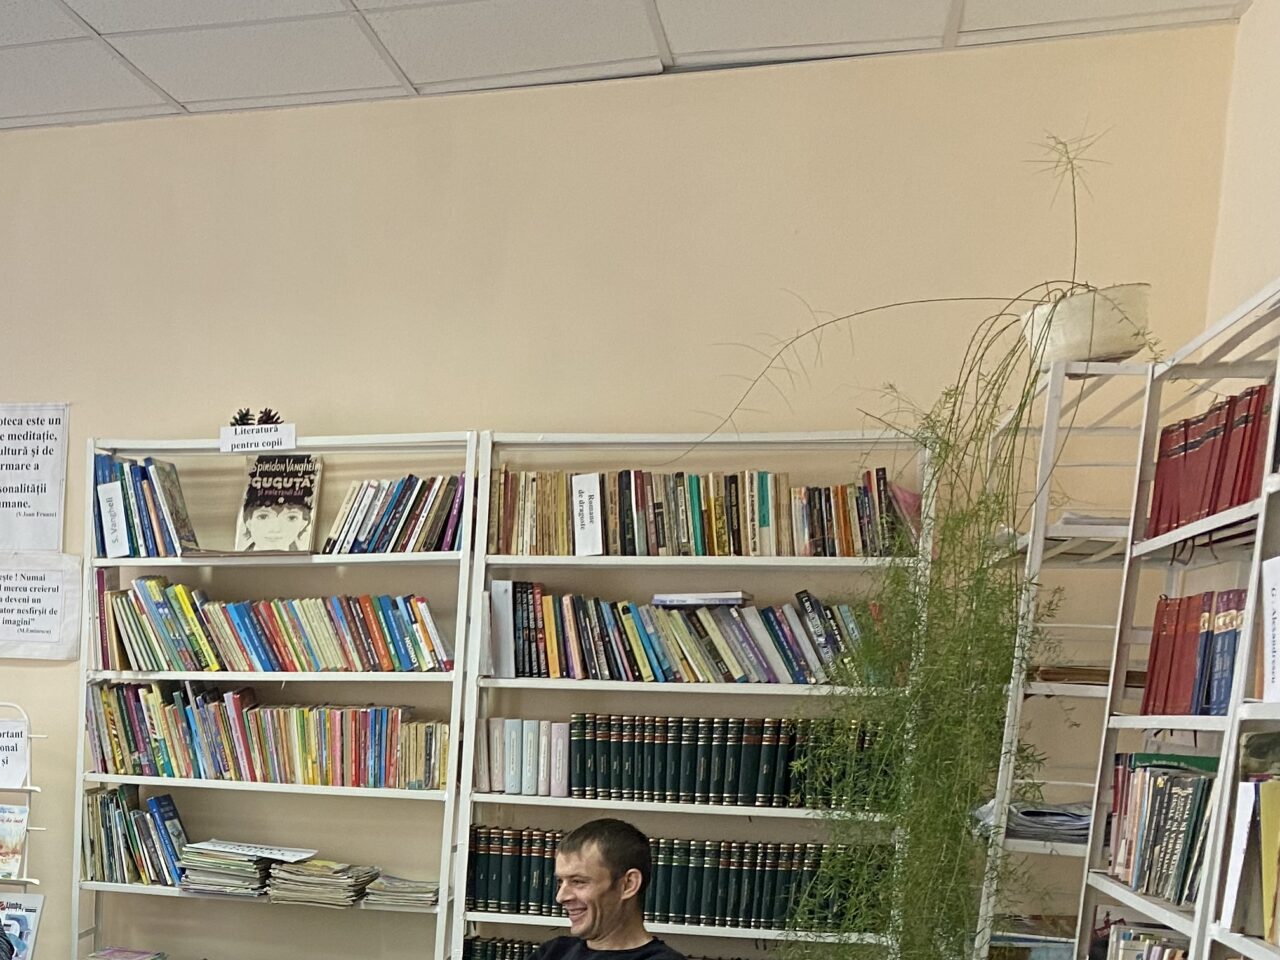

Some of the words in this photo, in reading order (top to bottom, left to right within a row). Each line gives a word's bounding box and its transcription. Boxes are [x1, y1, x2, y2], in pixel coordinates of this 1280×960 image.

[26, 416, 46, 426] este
[48, 418, 61, 426] un
[234, 426, 279, 436] Literatură
[230, 440, 260, 451] pentru
[262, 438, 283, 449] copii
[30, 445, 40, 458] și
[42, 445, 54, 456] de
[578, 490, 585, 498] de
[105, 497, 118, 531] Vangheli
[578, 500, 586, 531] dragoste
[112, 534, 118, 544] S.
[20, 573, 46, 582] Numai
[29, 585, 59, 593] creierul
[2, 756, 9, 767] și
